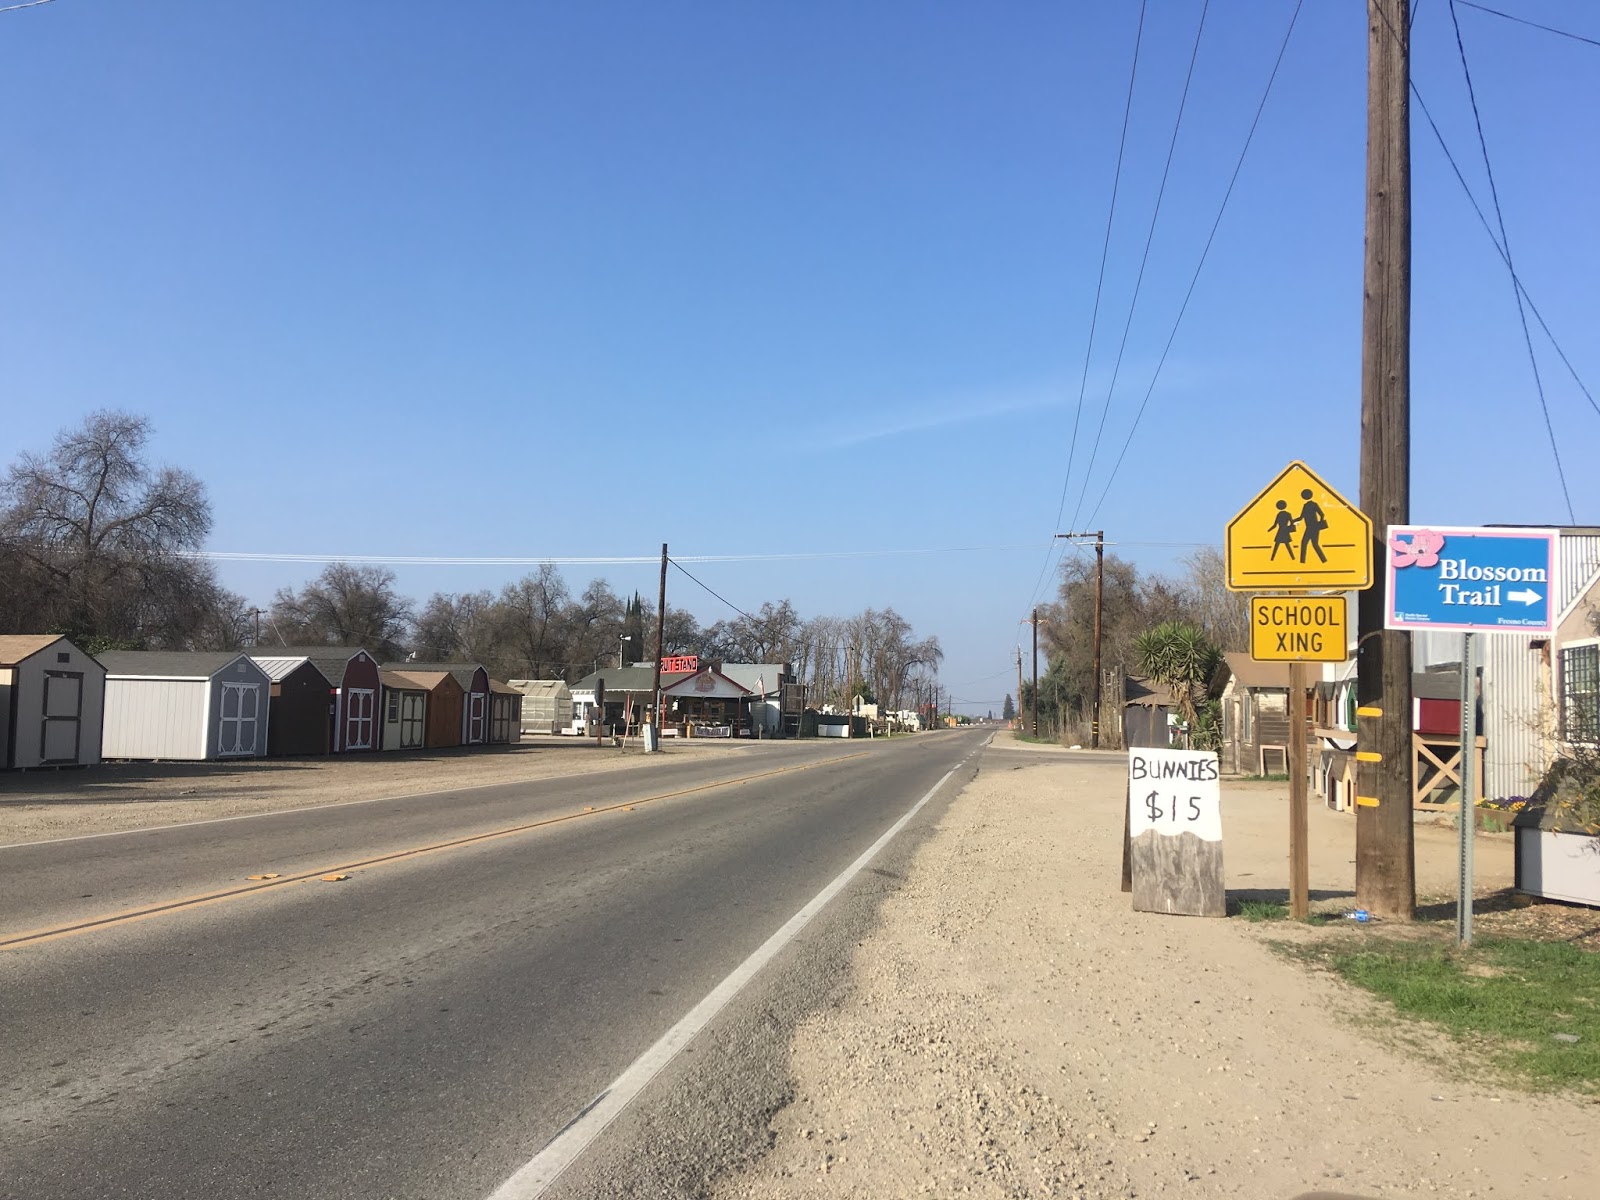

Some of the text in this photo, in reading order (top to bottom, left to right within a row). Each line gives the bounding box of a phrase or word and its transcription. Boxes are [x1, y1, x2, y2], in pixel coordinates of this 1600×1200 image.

[1438, 558, 1548, 583] Blossom
[1438, 583, 1502, 606] Trail
[1258, 605, 1340, 626] SCHOOL
[1498, 617, 1547, 627] Fresno County
[1276, 632, 1323, 653] XING
[660, 658, 697, 672] RUIT STAND
[1132, 756, 1218, 781] BUNNIES
[1145, 790, 1202, 823] $15
